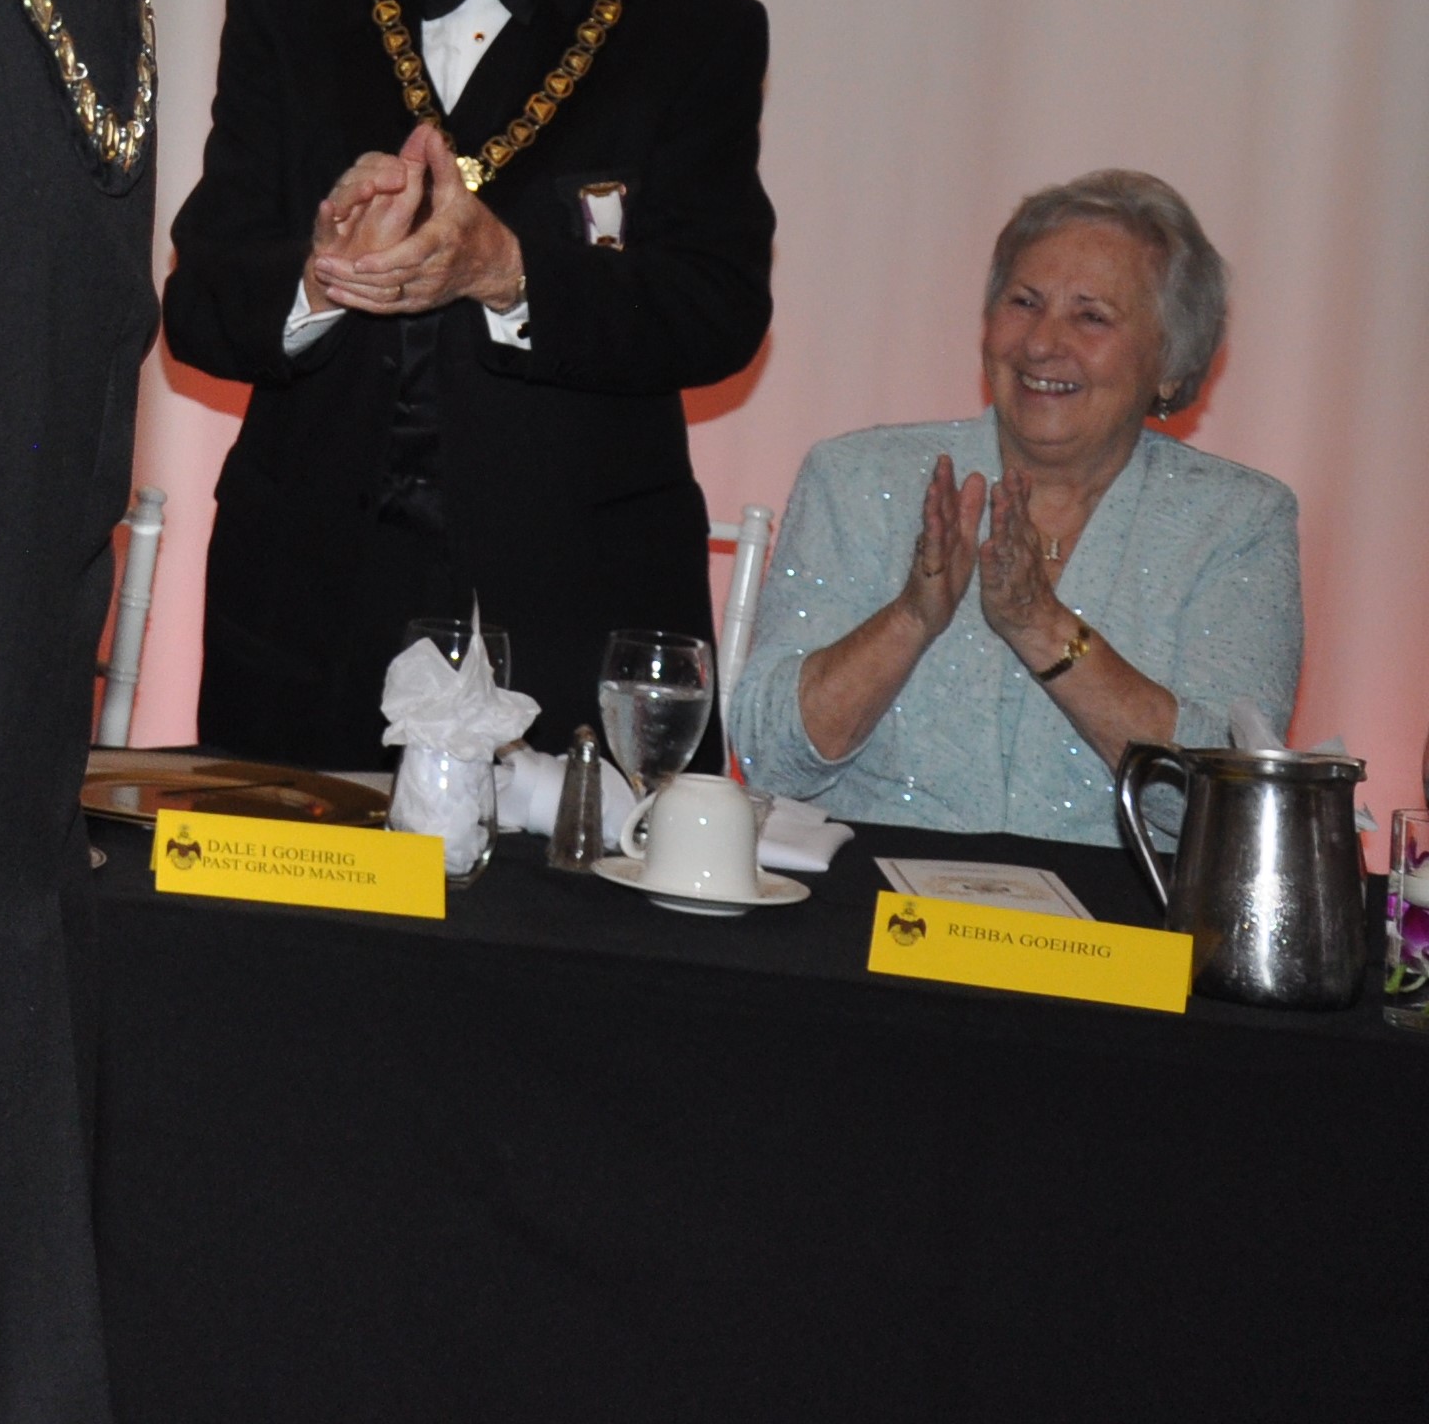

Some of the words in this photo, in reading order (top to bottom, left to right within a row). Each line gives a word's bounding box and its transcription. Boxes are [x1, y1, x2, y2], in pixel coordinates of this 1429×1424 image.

[207, 839, 255, 857] DALE
[261, 843, 268, 858] I
[273, 846, 355, 866] GOEHRIG
[202, 855, 242, 870] PAST
[245, 861, 305, 878] GRAND
[308, 866, 377, 885] MASTER
[948, 923, 1014, 945] REBBA
[1019, 934, 1112, 958] GOEHRIG
